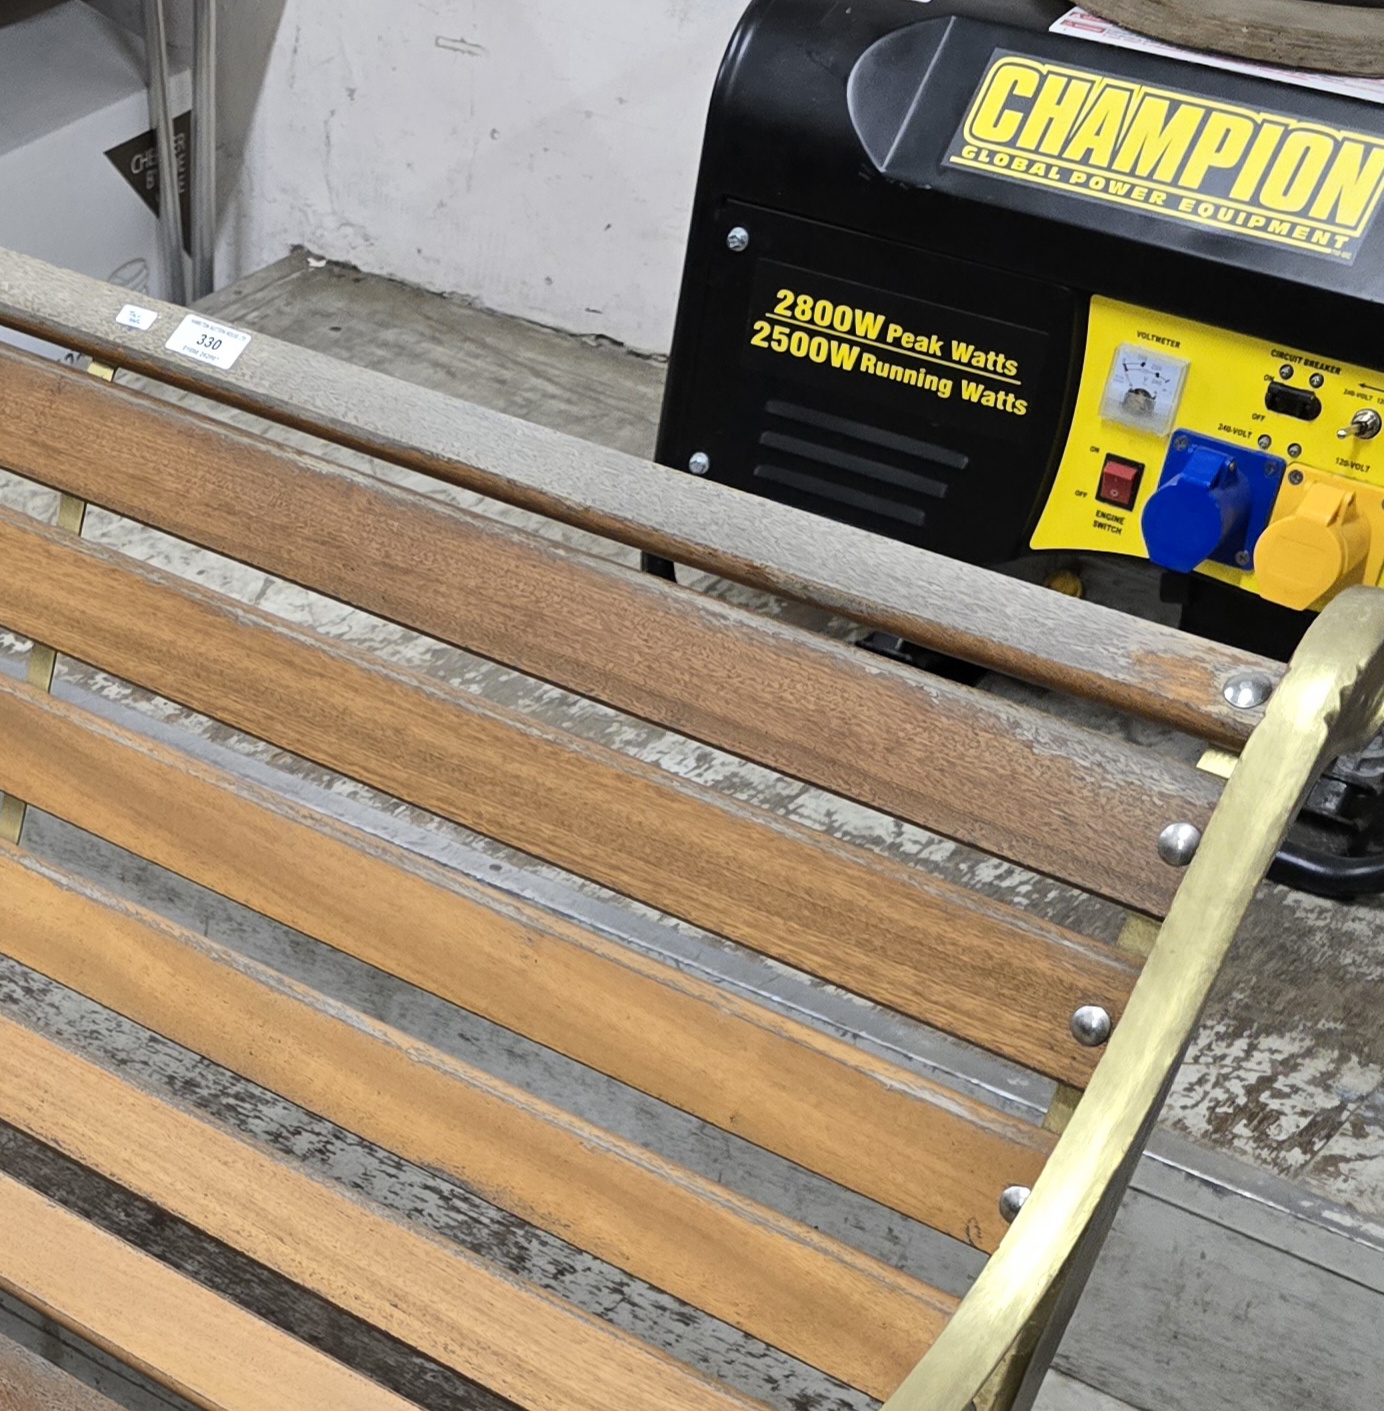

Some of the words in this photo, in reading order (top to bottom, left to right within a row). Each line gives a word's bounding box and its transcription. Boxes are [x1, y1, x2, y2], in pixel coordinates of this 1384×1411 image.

[972, 66, 1384, 227] CHAMPION
[961, 145, 1060, 179] GLOBAL
[1069, 171, 1166, 205] POWER
[1178, 198, 1349, 249] EQUIPMENT
[773, 288, 885, 340] 2800W
[886, 324, 944, 357] Peak
[951, 340, 1019, 377] Watts
[1137, 330, 1181, 349] VOLTMETER
[196, 333, 223, 351] 330
[750, 320, 861, 372] 2500W
[860, 353, 953, 399] Running
[961, 379, 1028, 416] Watts
[1270, 349, 1304, 365] CIRCUIT
[1303, 358, 1342, 376] BREAKER
[1252, 413, 1266, 422] OFF
[1089, 446, 1100, 454] ON
[1074, 489, 1088, 498] OFF
[1095, 509, 1125, 526] ENGINE
[1092, 519, 1123, 536] SWITCH
